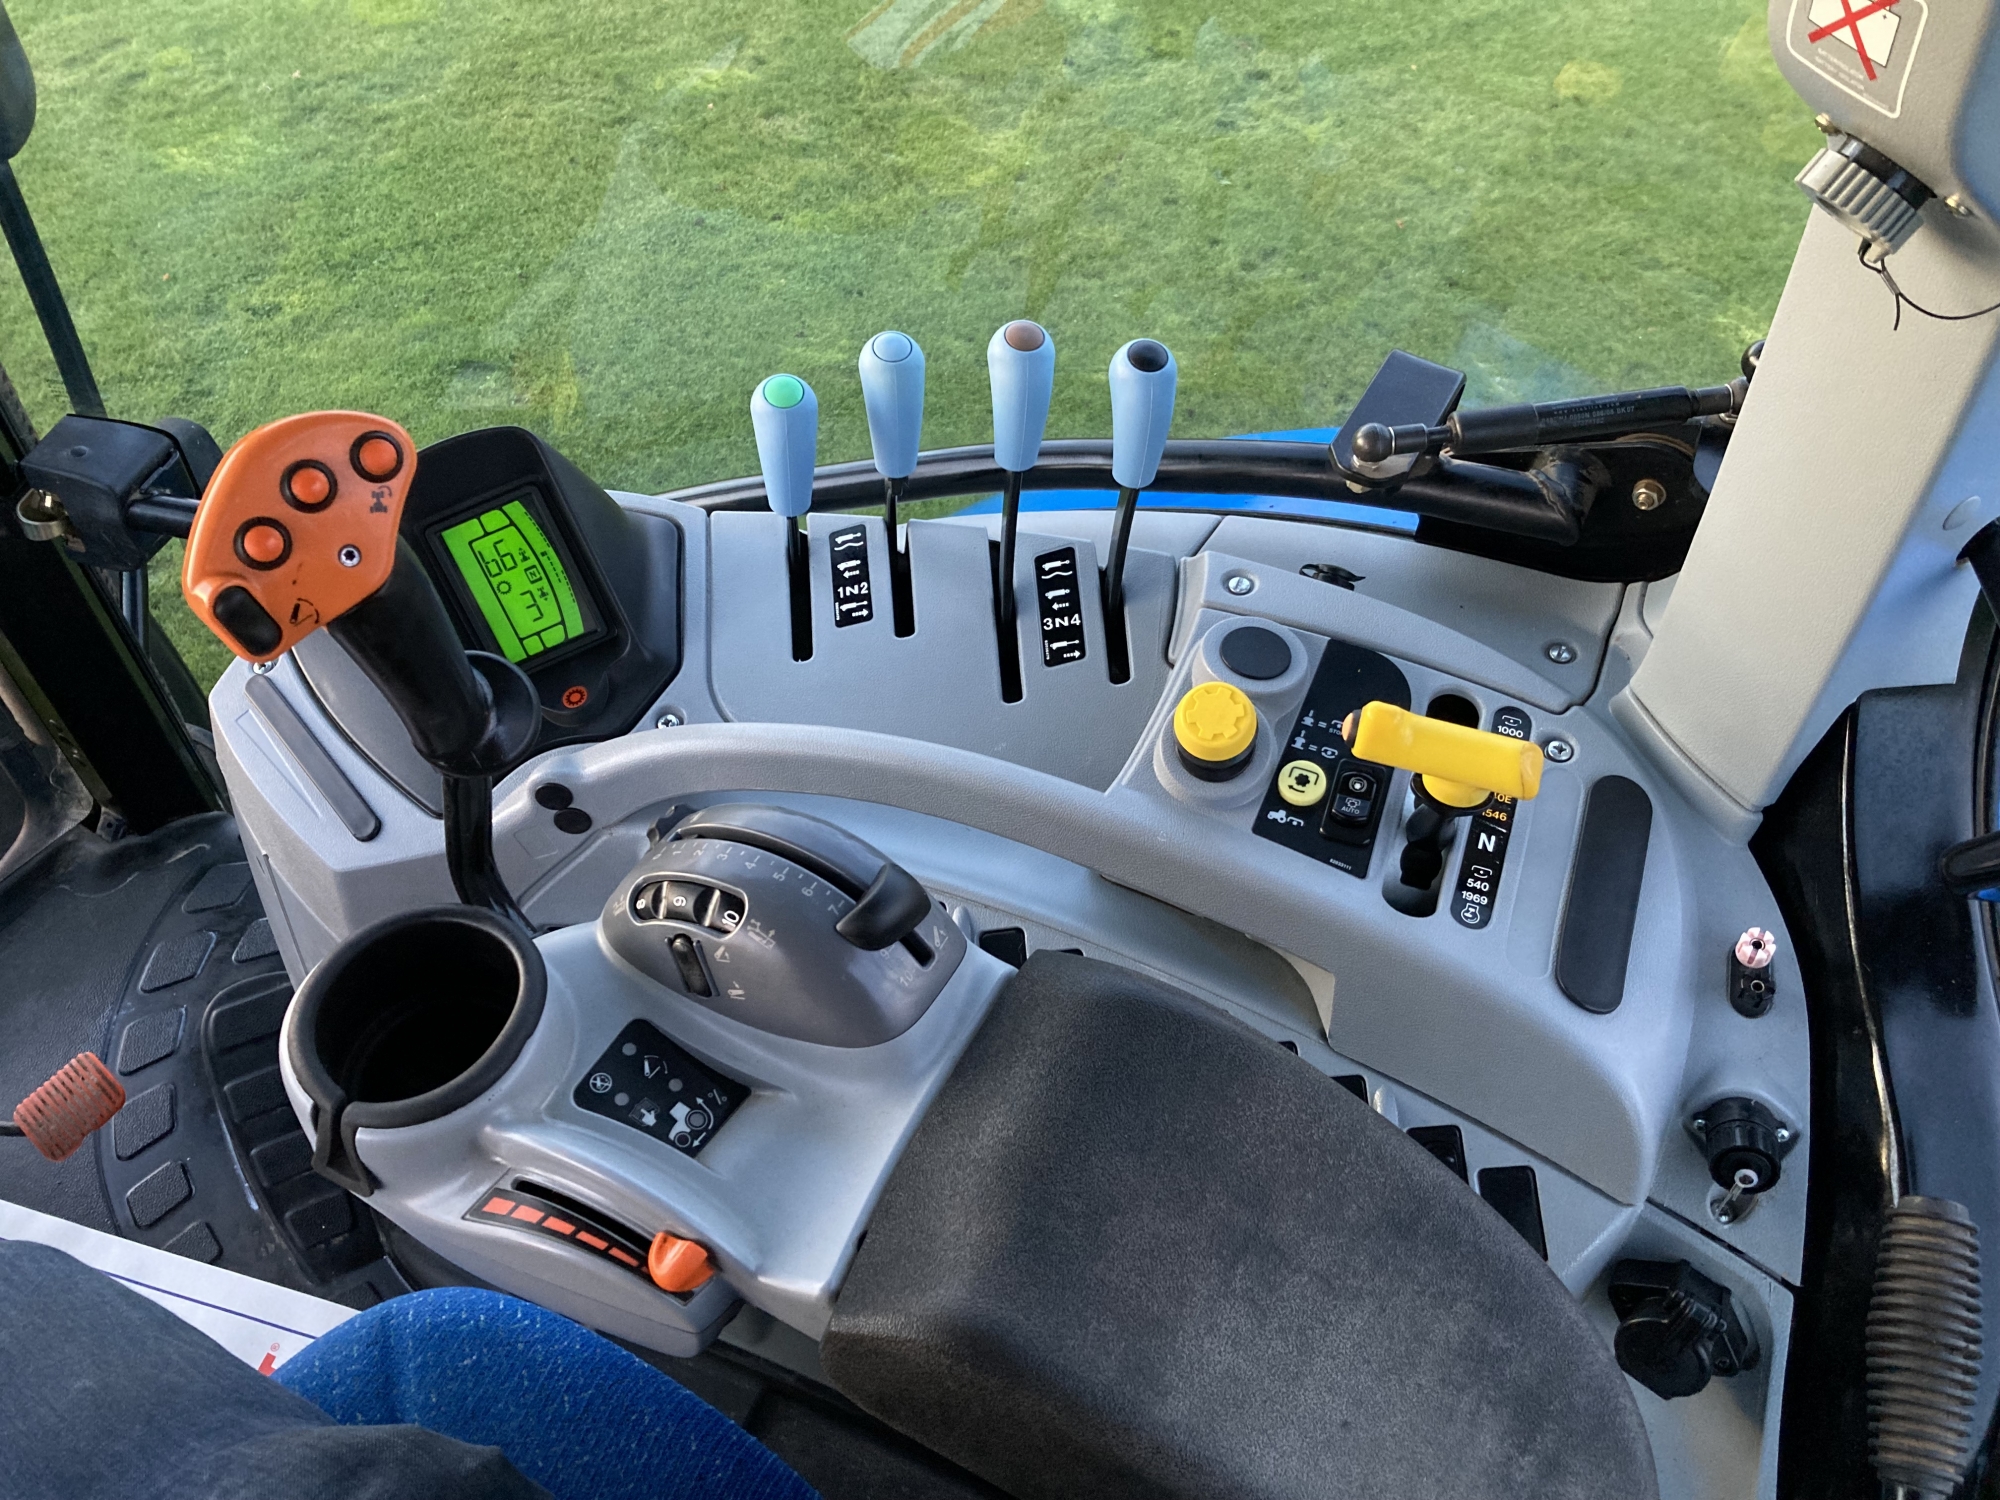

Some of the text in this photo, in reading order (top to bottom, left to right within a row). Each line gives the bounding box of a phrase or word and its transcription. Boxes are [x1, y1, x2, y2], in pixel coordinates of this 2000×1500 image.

[1328, 727, 1342, 736] STO
[1497, 725, 1524, 738] 1000
[1340, 805, 1360, 815] AUTO
[1482, 808, 1507, 821] 546
[1477, 832, 1496, 852] N
[716, 853, 728, 861] 3
[745, 861, 757, 869] 4
[772, 872, 786, 882] 5
[1466, 878, 1490, 892] 540
[801, 886, 814, 897] 6
[673, 896, 687, 907] 9
[1461, 890, 1488, 905] 1969
[636, 898, 646, 910] 8
[827, 904, 840, 915] 7
[721, 910, 740, 928] 10
[900, 970, 913, 987] 10
